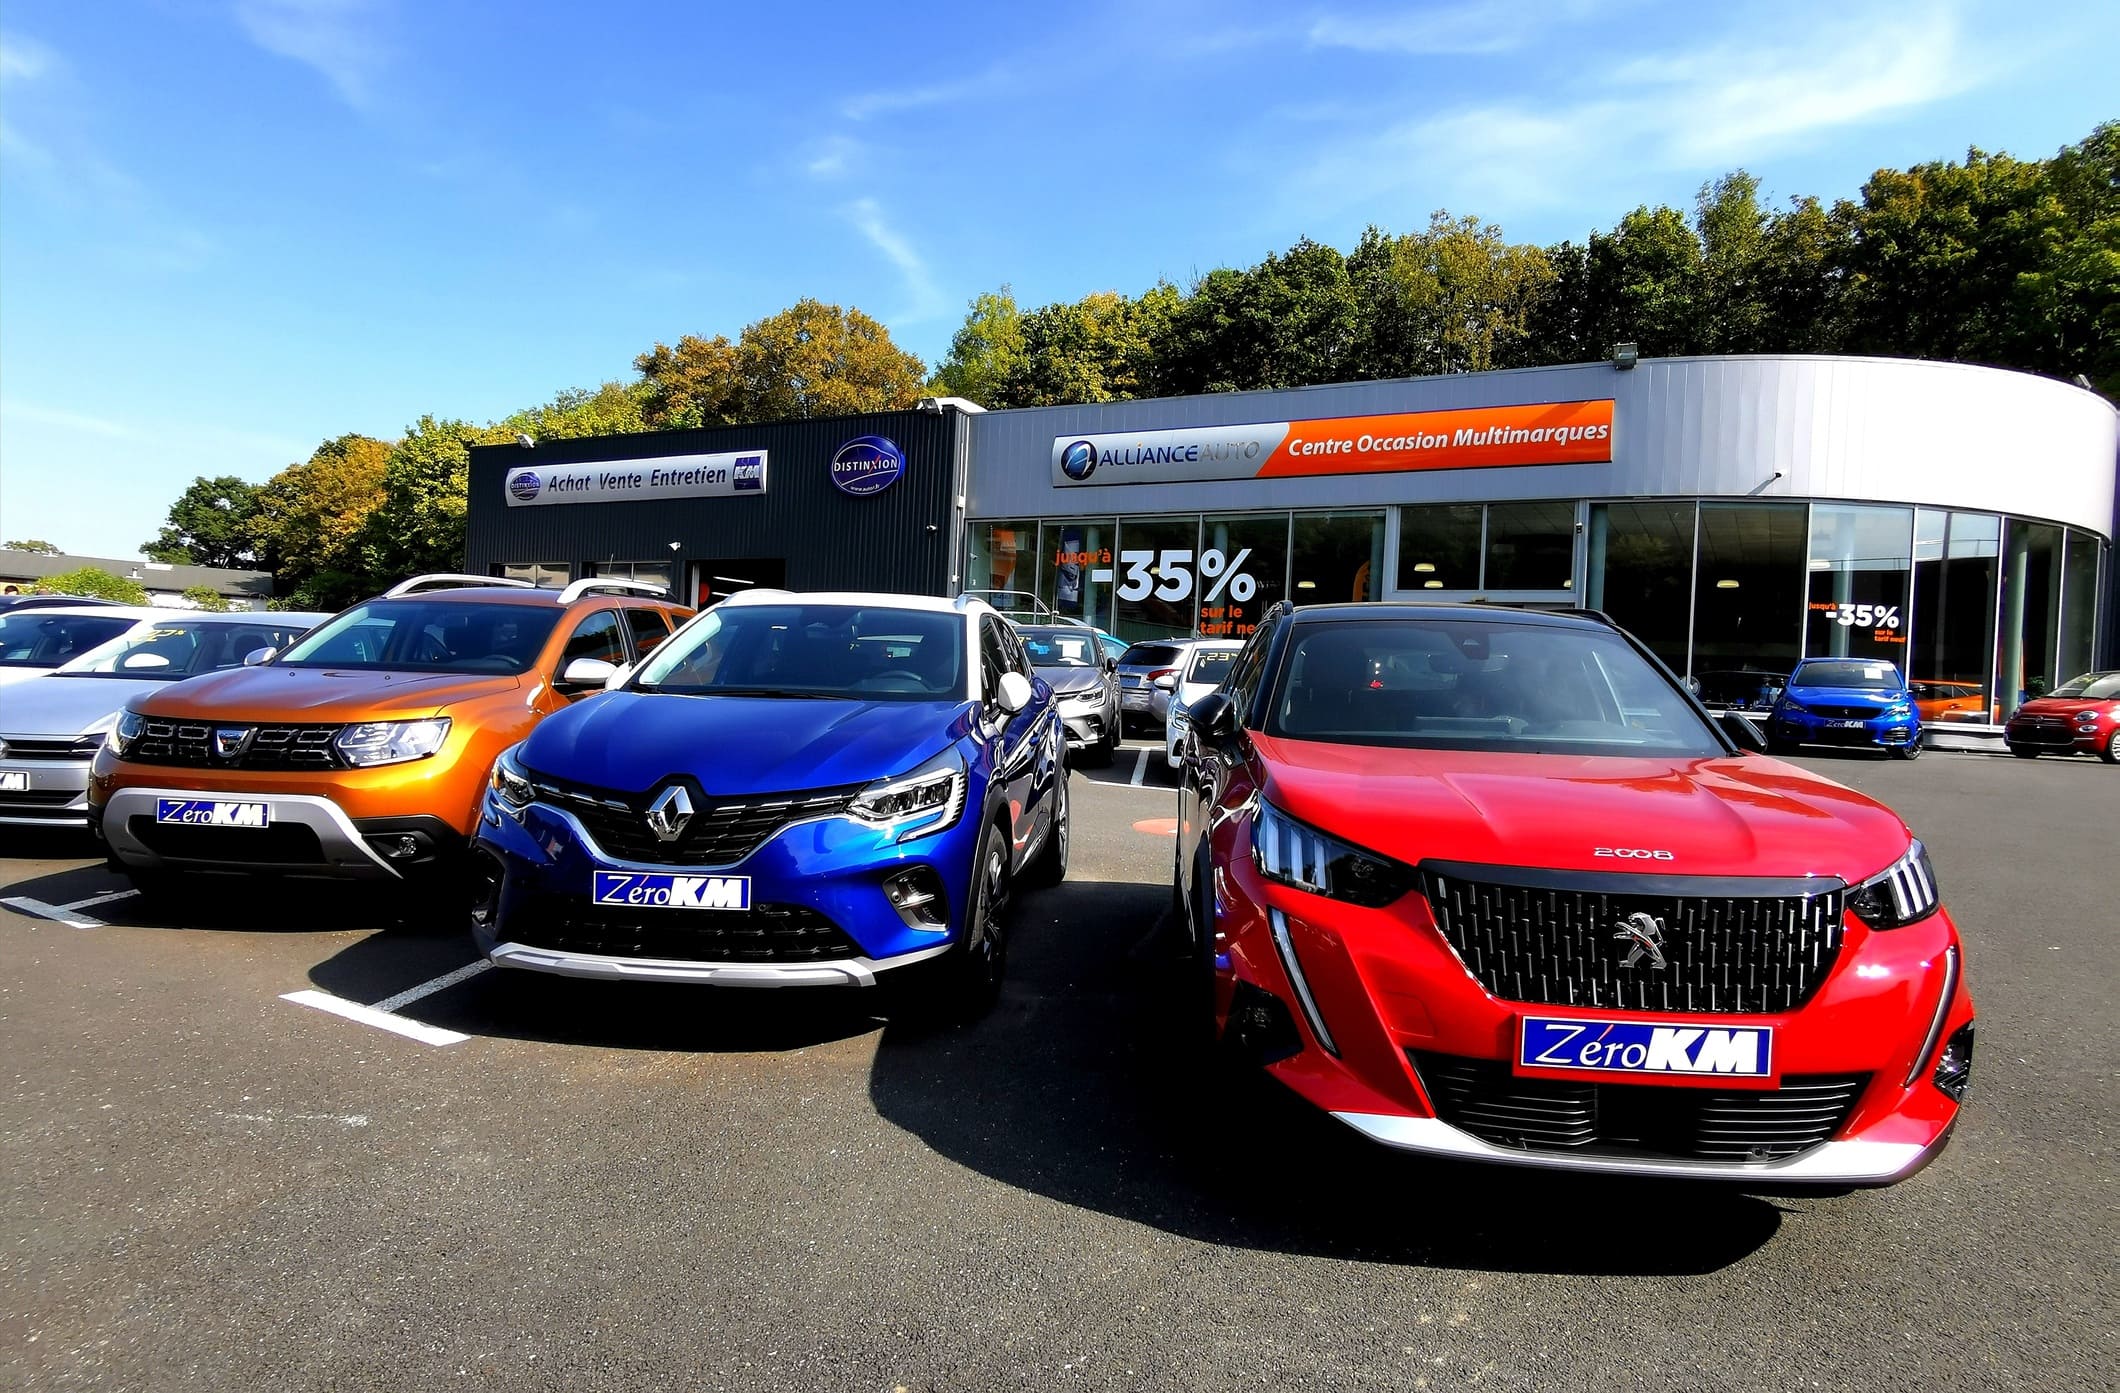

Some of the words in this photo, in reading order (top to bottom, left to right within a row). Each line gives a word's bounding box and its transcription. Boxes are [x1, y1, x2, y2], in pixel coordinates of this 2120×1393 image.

[1288, 438, 1353, 456] Centre
[1357, 432, 1447, 452] Occasion
[1453, 425, 1609, 447] Multimarques
[834, 456, 897, 473] DISTINXION
[548, 474, 592, 492] Achat
[600, 472, 642, 490] Vente
[651, 466, 726, 486] Entretien
[1054, 548, 1112, 567] jusqu'à
[1091, 548, 1257, 602] -35%
[1201, 607, 1225, 618] sur
[1229, 605, 1243, 618] le
[1826, 603, 1900, 628] -35%
[1200, 622, 1233, 634] tarif
[1237, 624, 1256, 635] ne
[1593, 847, 1674, 860] 2008
